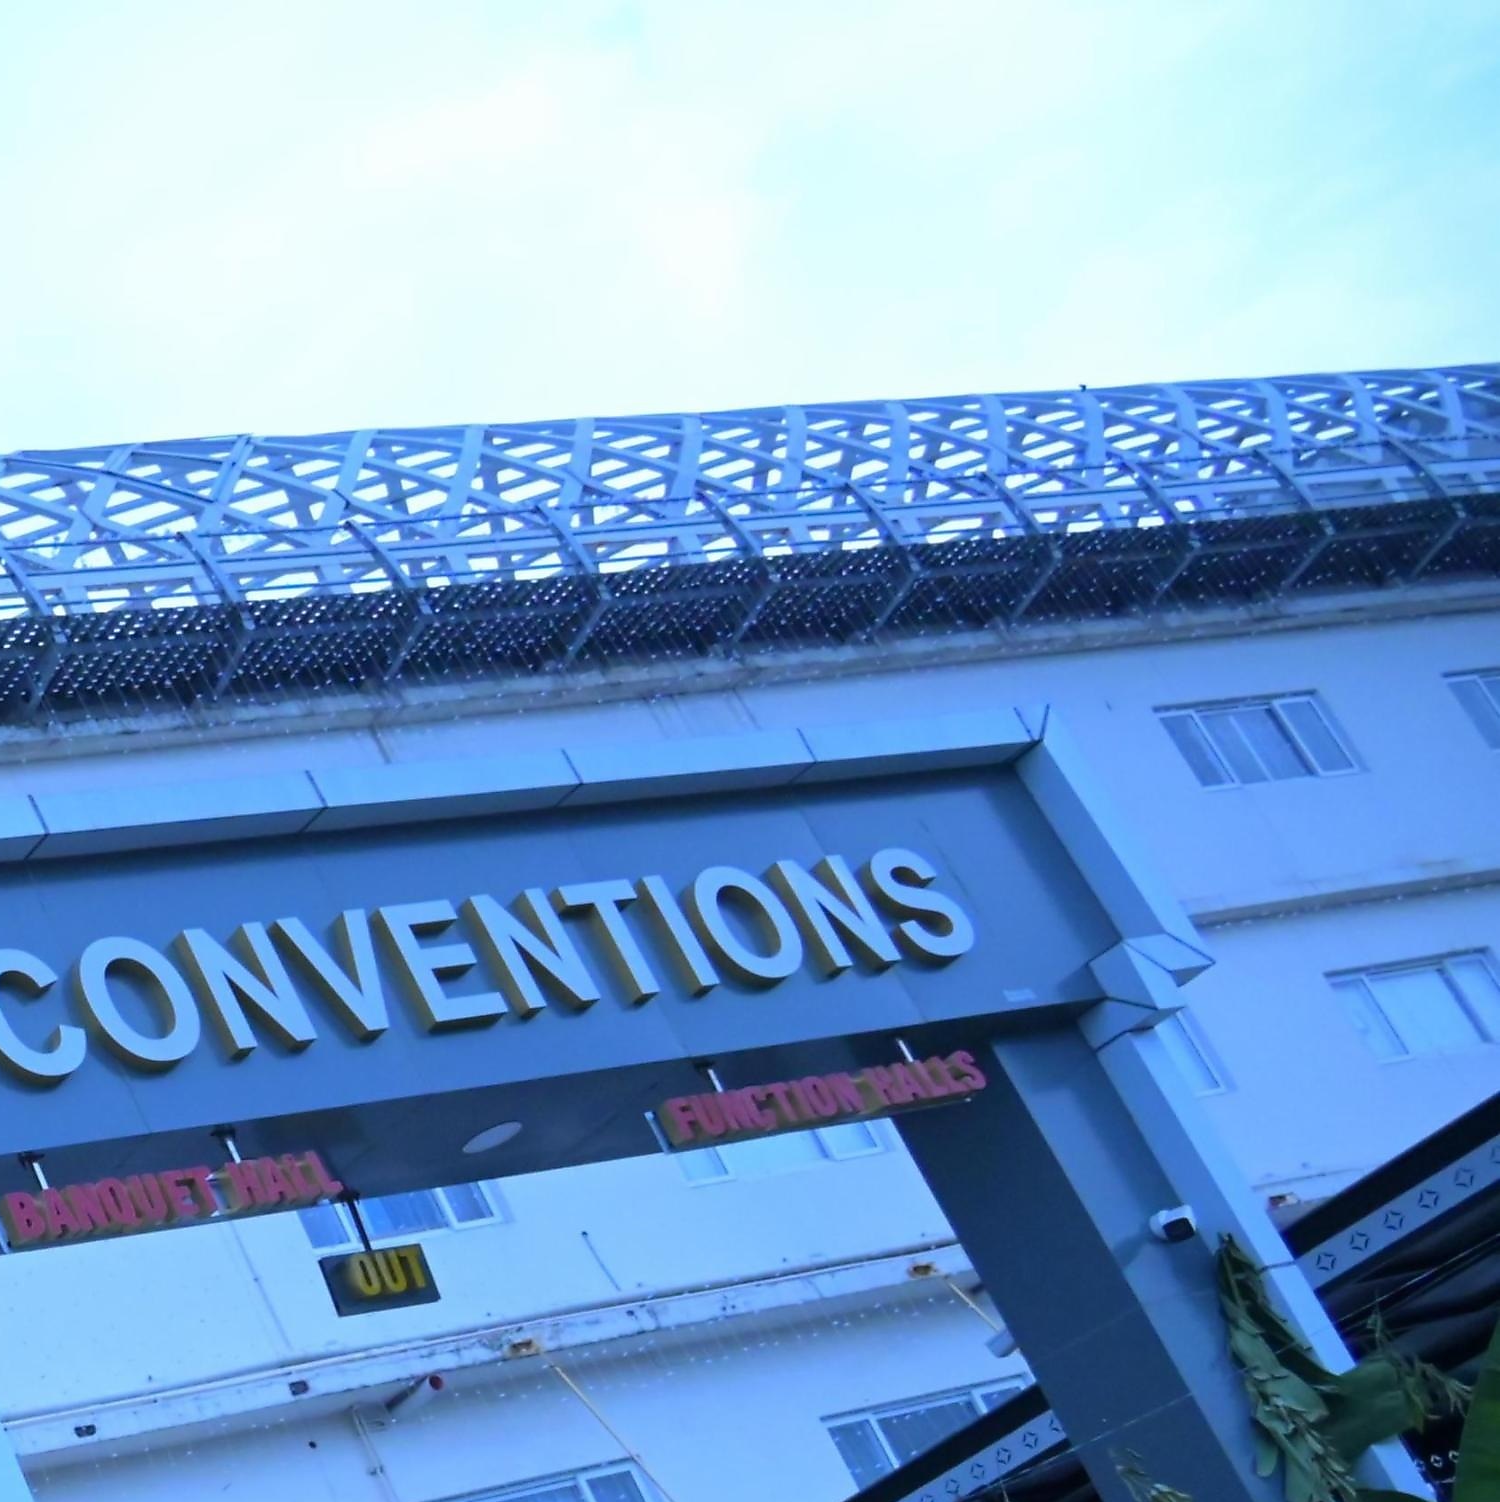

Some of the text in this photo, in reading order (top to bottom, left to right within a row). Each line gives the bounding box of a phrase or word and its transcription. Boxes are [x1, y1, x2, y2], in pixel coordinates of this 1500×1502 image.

[665, 1050, 986, 1142] FUNCTION HALLS
[3, 1150, 343, 1242] BANQUET HALL
[350, 1248, 427, 1297] OUT
